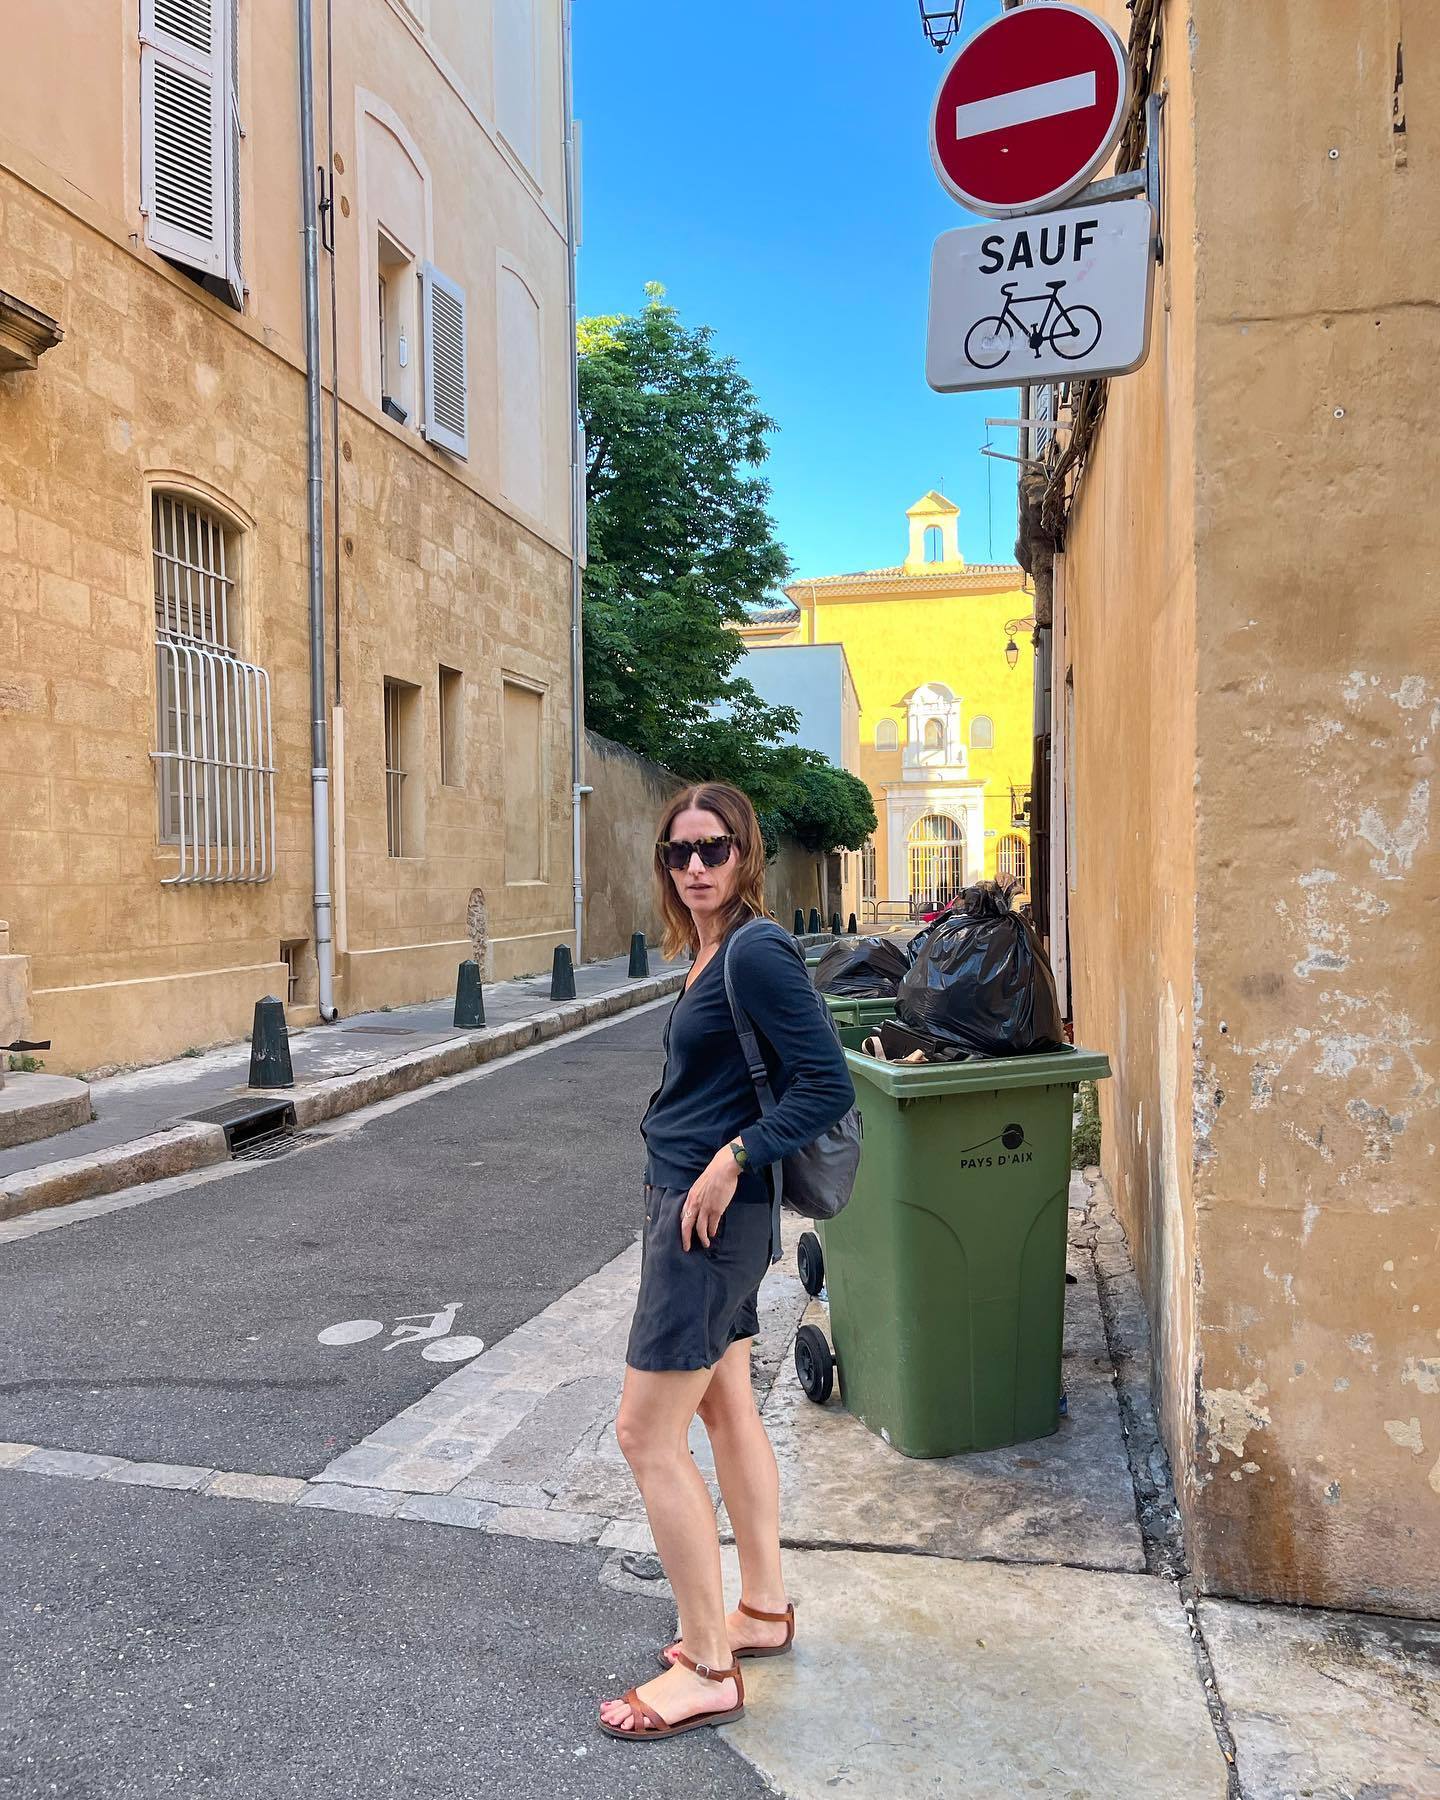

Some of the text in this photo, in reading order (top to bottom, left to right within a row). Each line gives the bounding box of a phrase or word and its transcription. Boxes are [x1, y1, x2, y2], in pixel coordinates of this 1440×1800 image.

[978, 220, 1099, 275] SAUF
[960, 1152, 1033, 1169] PAYS D'AIX
